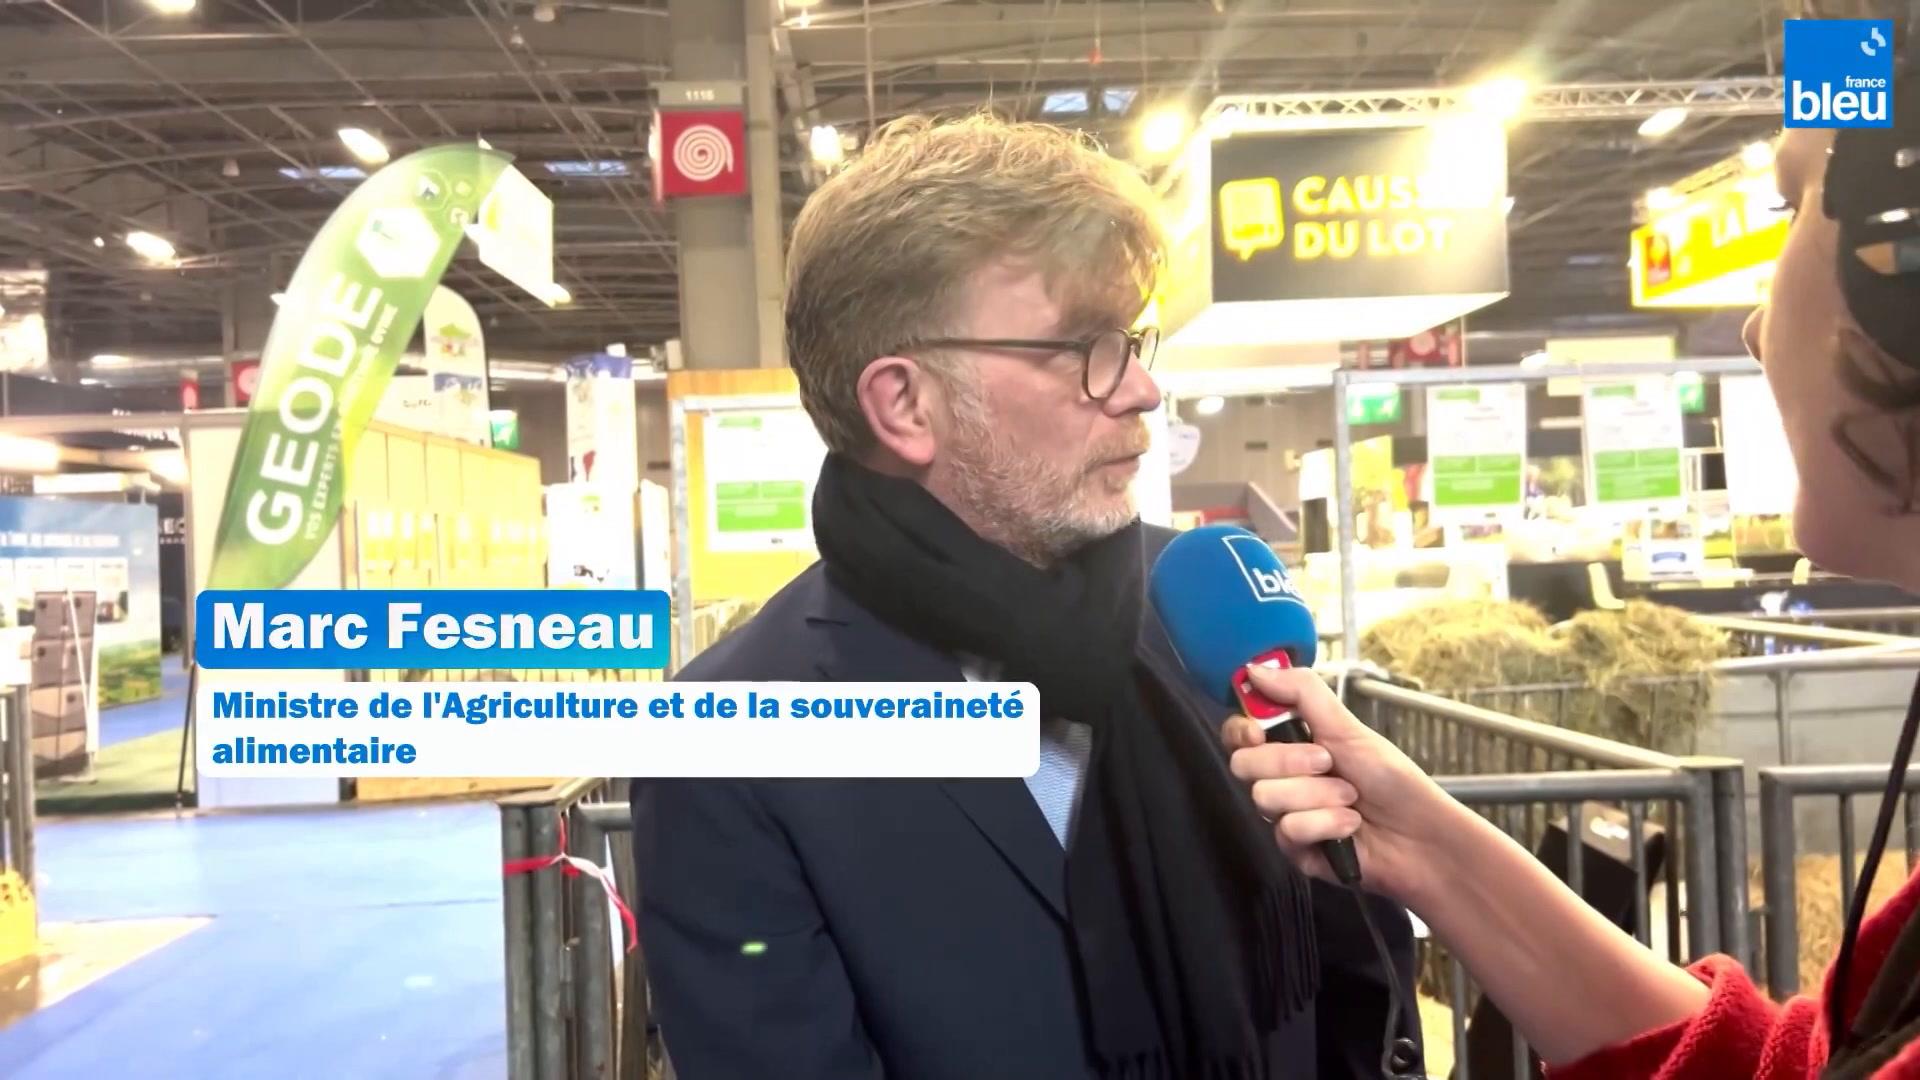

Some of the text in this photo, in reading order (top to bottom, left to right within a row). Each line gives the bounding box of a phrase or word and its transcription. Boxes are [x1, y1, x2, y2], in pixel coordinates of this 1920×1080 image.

[1292, 175, 1444, 214] CAUS
[1294, 216, 1453, 260] DU LOT
[245, 270, 384, 545] GEODE
[312, 441, 340, 511] EXPERTS
